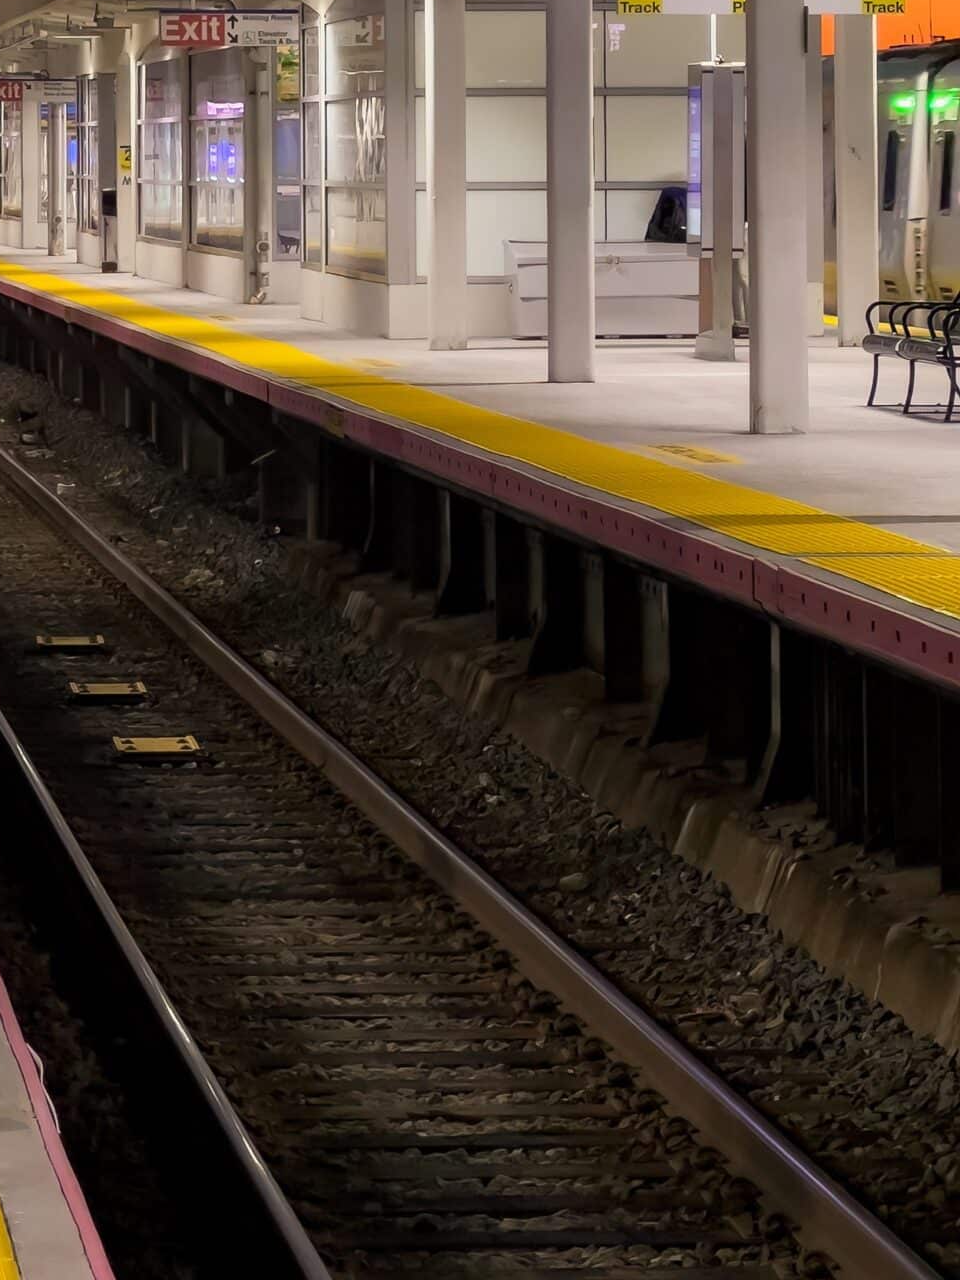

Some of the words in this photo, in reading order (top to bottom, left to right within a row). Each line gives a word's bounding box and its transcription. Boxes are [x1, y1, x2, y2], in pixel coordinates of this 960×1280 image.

[620, 2, 661, 13] Track
[864, 1, 904, 13] Track
[161, 15, 220, 41] Exit
